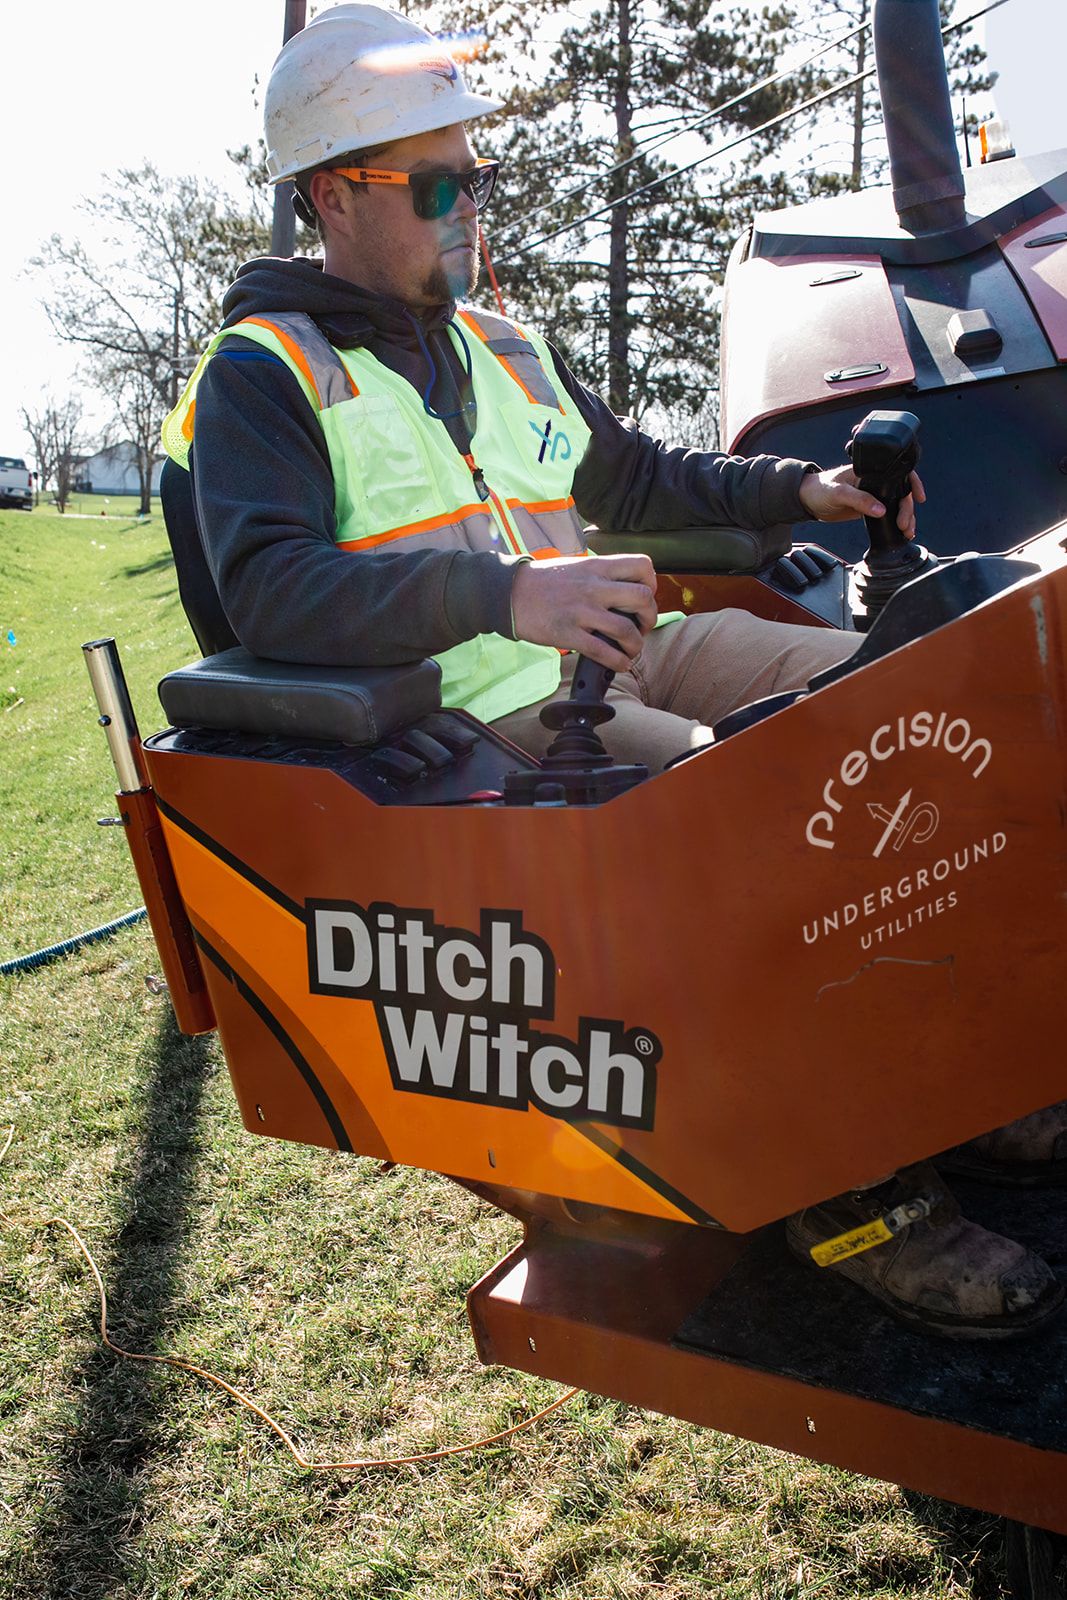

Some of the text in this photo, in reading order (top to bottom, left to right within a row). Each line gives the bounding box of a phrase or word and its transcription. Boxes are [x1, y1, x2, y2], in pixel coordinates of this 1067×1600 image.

[806, 711, 992, 850] precision
[802, 832, 1007, 944] UNDERGROUND
[860, 891, 958, 950] UTILITIES
[315, 910, 544, 1007] Ditch
